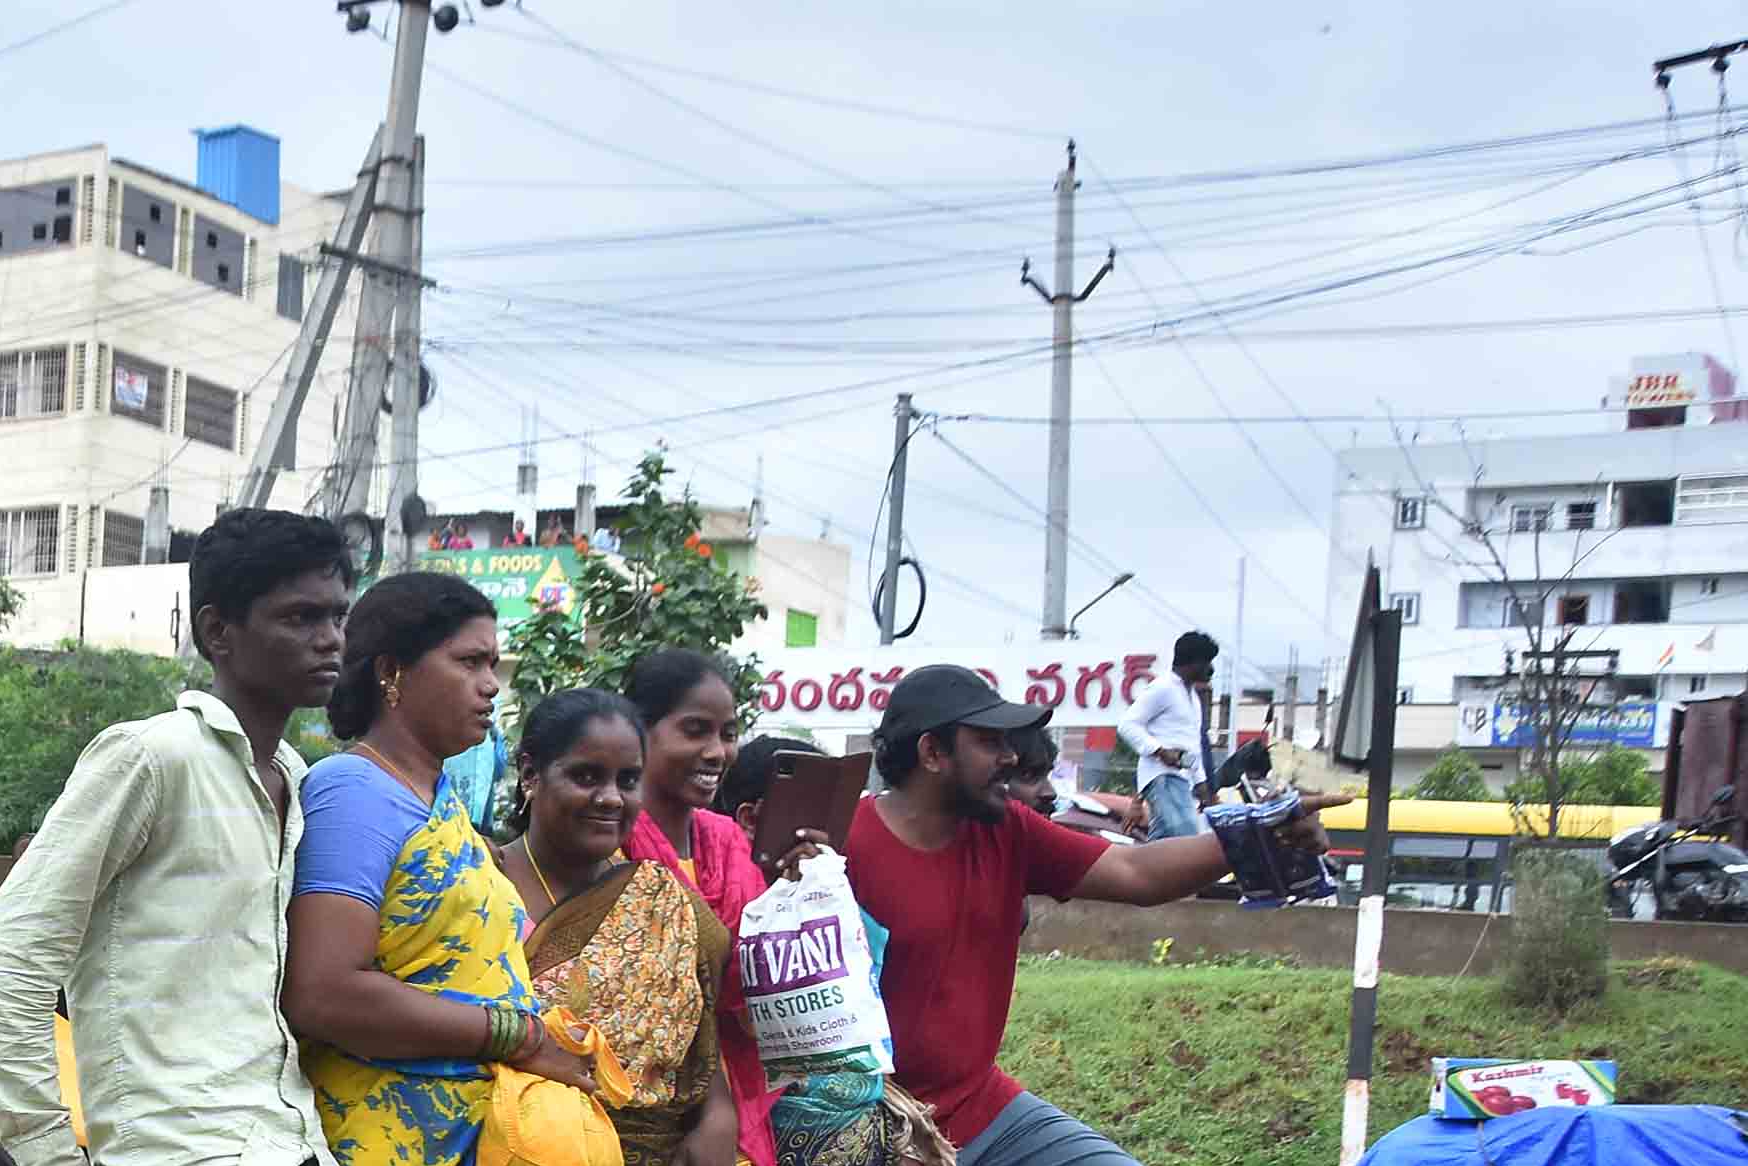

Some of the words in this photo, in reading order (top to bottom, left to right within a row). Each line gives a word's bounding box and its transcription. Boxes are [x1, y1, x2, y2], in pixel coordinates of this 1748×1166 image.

[489, 554, 542, 575] FOODS
[739, 938, 759, 987] RI
[762, 924, 842, 986] VANI
[773, 985, 845, 1021] STORES
[796, 1023, 819, 1037] Kids
[819, 1017, 849, 1032] Cloth
[790, 1033, 843, 1050] Showroom
